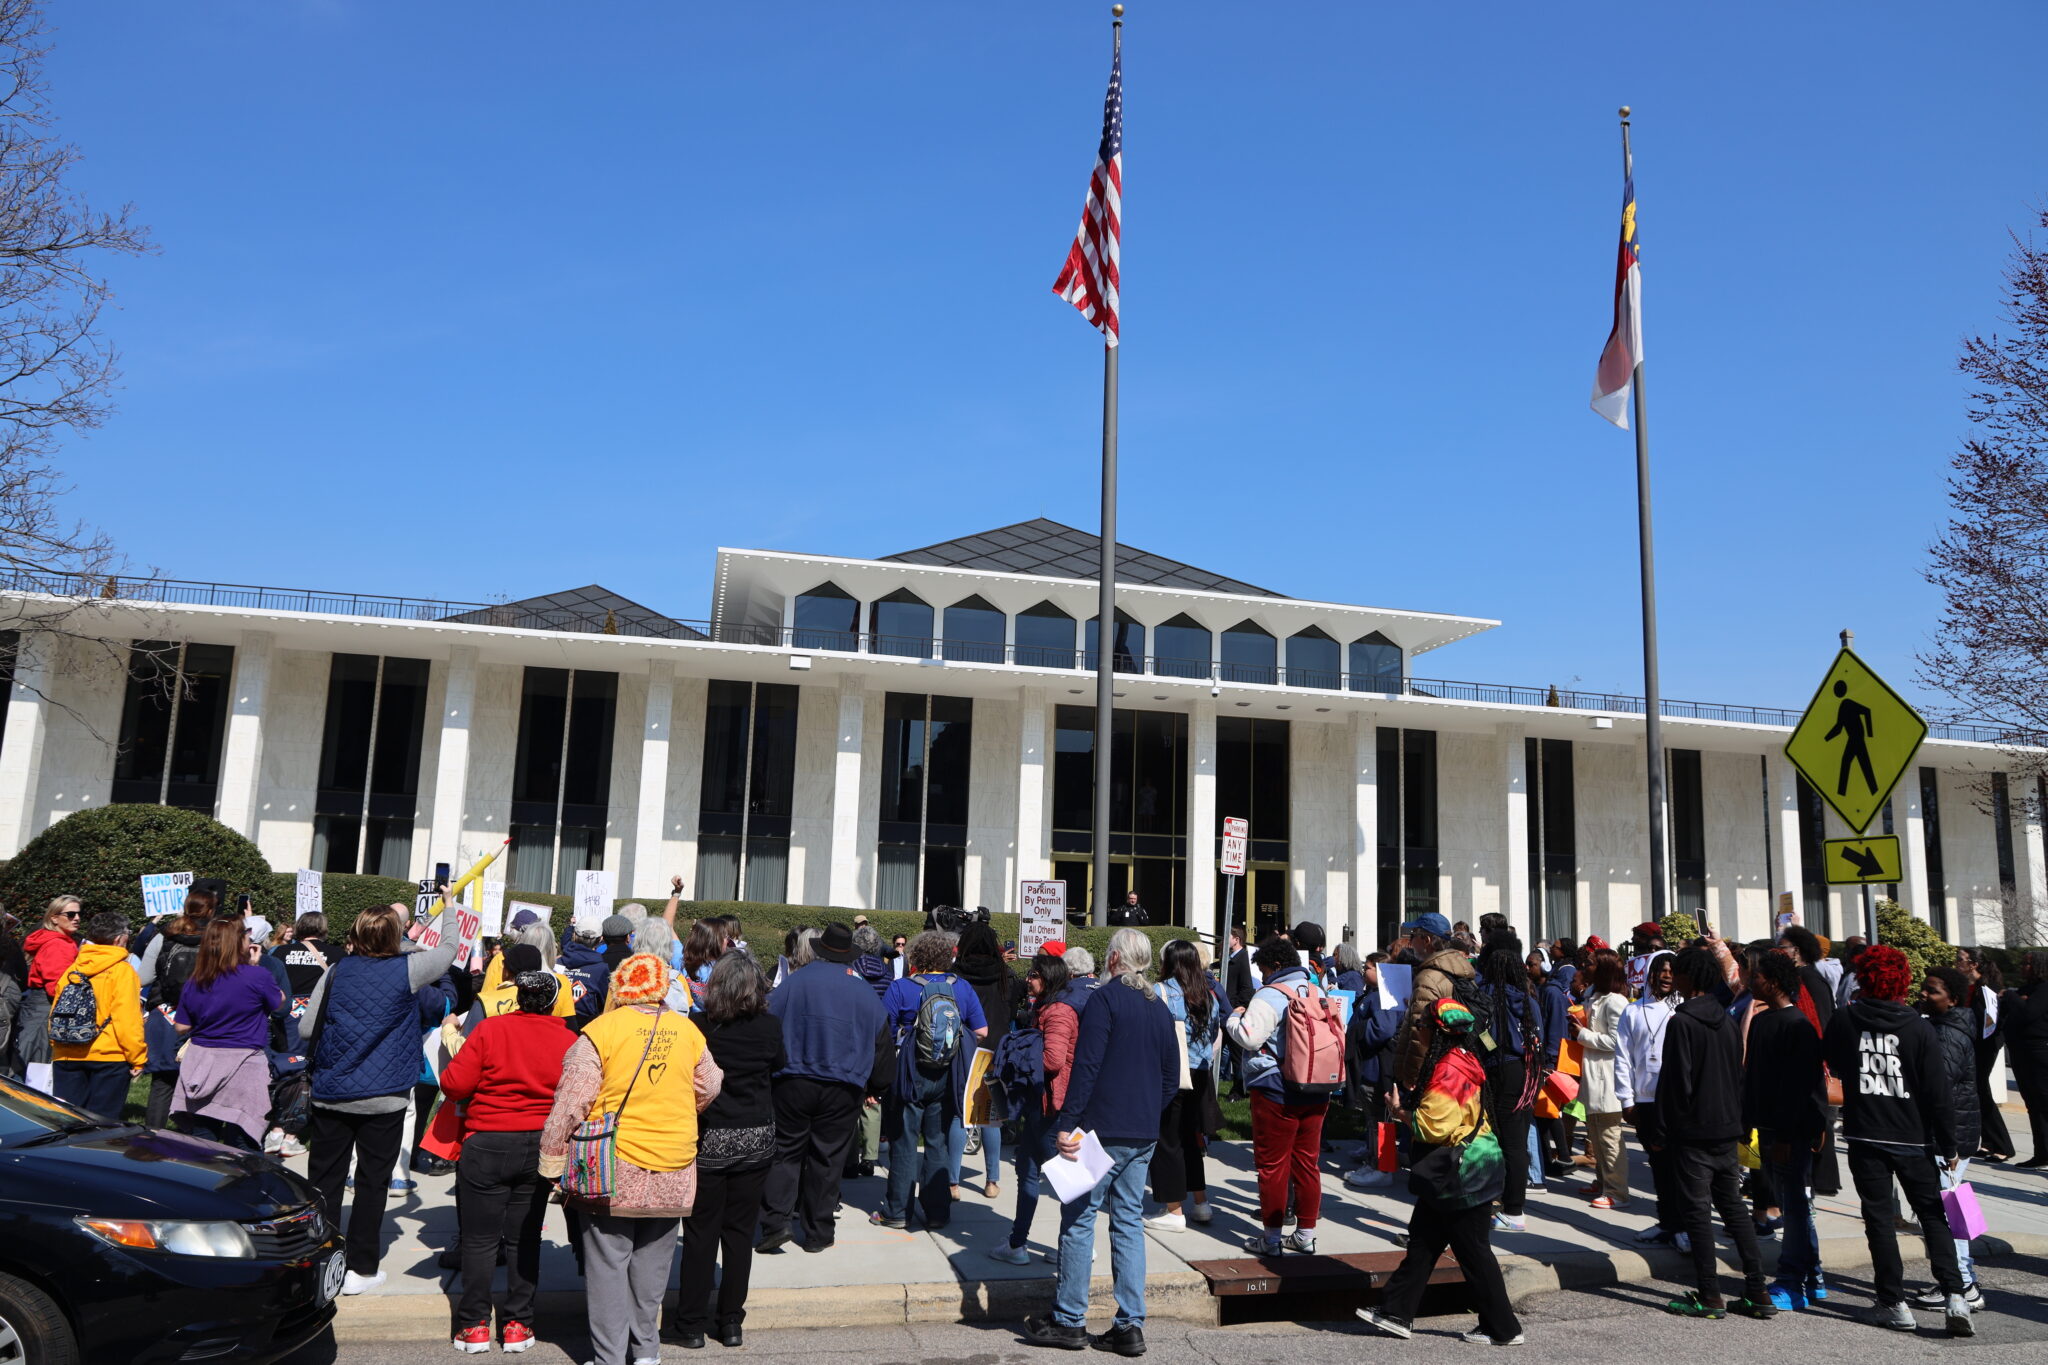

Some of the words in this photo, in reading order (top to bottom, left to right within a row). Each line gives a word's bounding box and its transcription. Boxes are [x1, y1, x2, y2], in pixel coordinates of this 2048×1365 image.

[1227, 839, 1242, 850] ANY
[1226, 851, 1242, 863] TIME
[144, 875, 171, 888] FUND
[172, 873, 191, 886] OUR
[586, 872, 598, 884] #1
[299, 883, 319, 899] CUTS
[1027, 886, 1056, 897] Parking
[584, 896, 600, 907] #48
[1024, 895, 1035, 907] By
[1036, 895, 1061, 905] Permit
[1033, 906, 1052, 917] Only
[1028, 925, 1037, 934] All
[1039, 925, 1056, 935] Others
[1023, 935, 1034, 944] Will
[1035, 935, 1043, 945] Be
[657, 1036, 671, 1044] the
[1859, 1031, 1900, 1056] AIR
[643, 1043, 661, 1053] ide
[664, 1042, 674, 1057] of
[1860, 1052, 1902, 1077] JOR
[1860, 1073, 1910, 1099] DAN.
